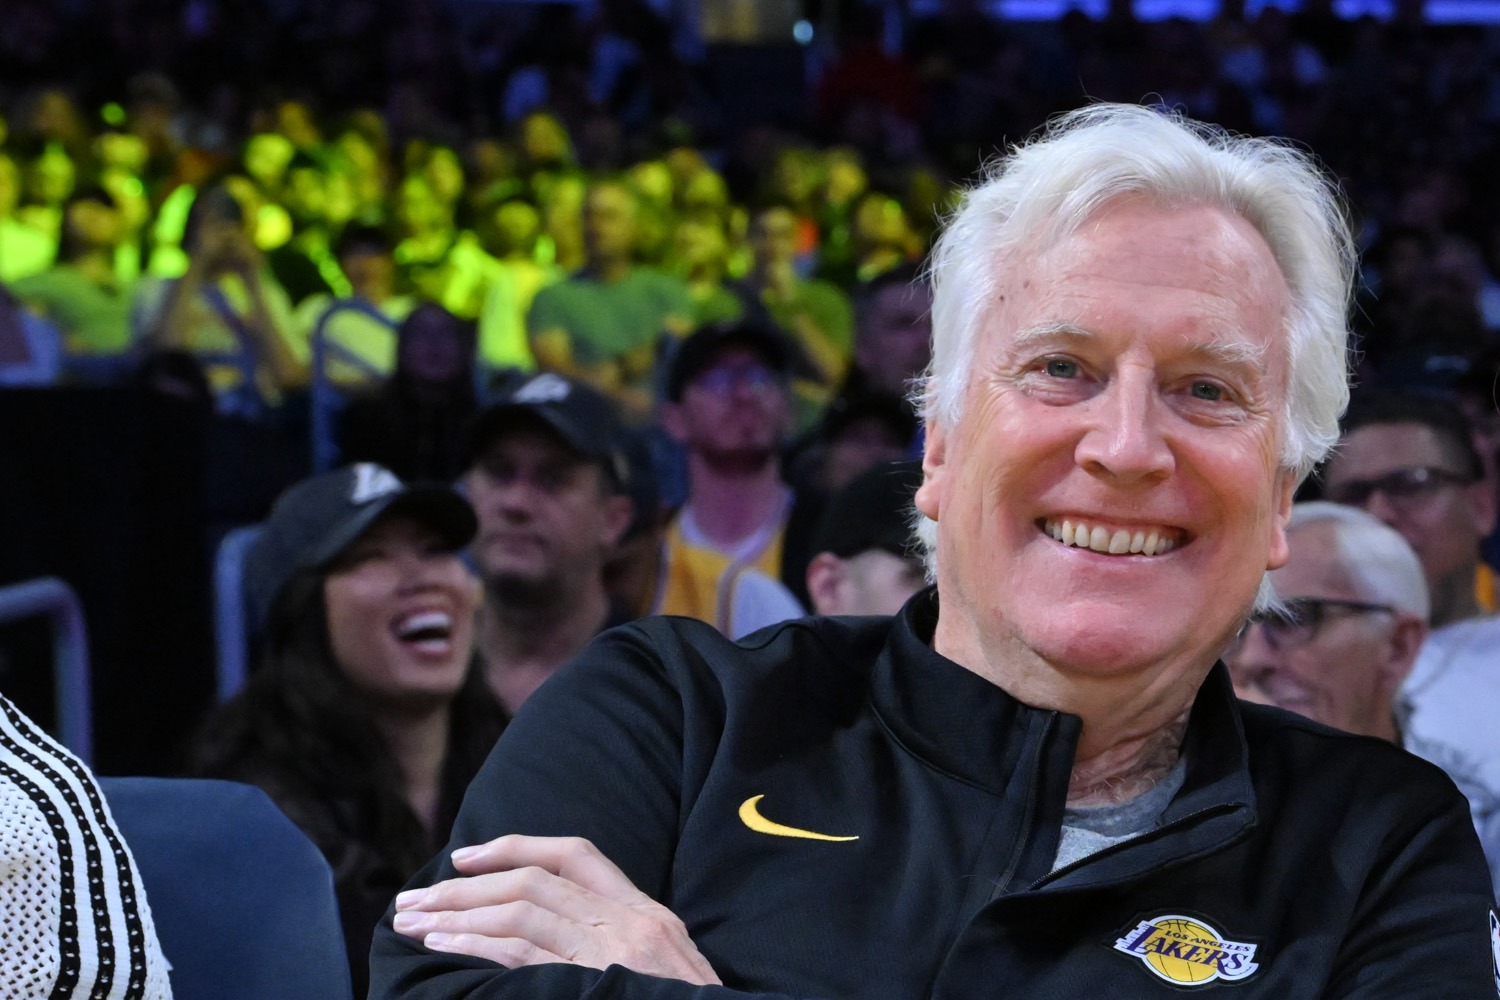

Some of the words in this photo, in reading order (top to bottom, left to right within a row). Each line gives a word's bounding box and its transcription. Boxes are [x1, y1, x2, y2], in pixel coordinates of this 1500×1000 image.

[1125, 924, 1252, 976] LAKERS
[1164, 930, 1189, 941] LOS
[1190, 937, 1251, 953] ANGELES
